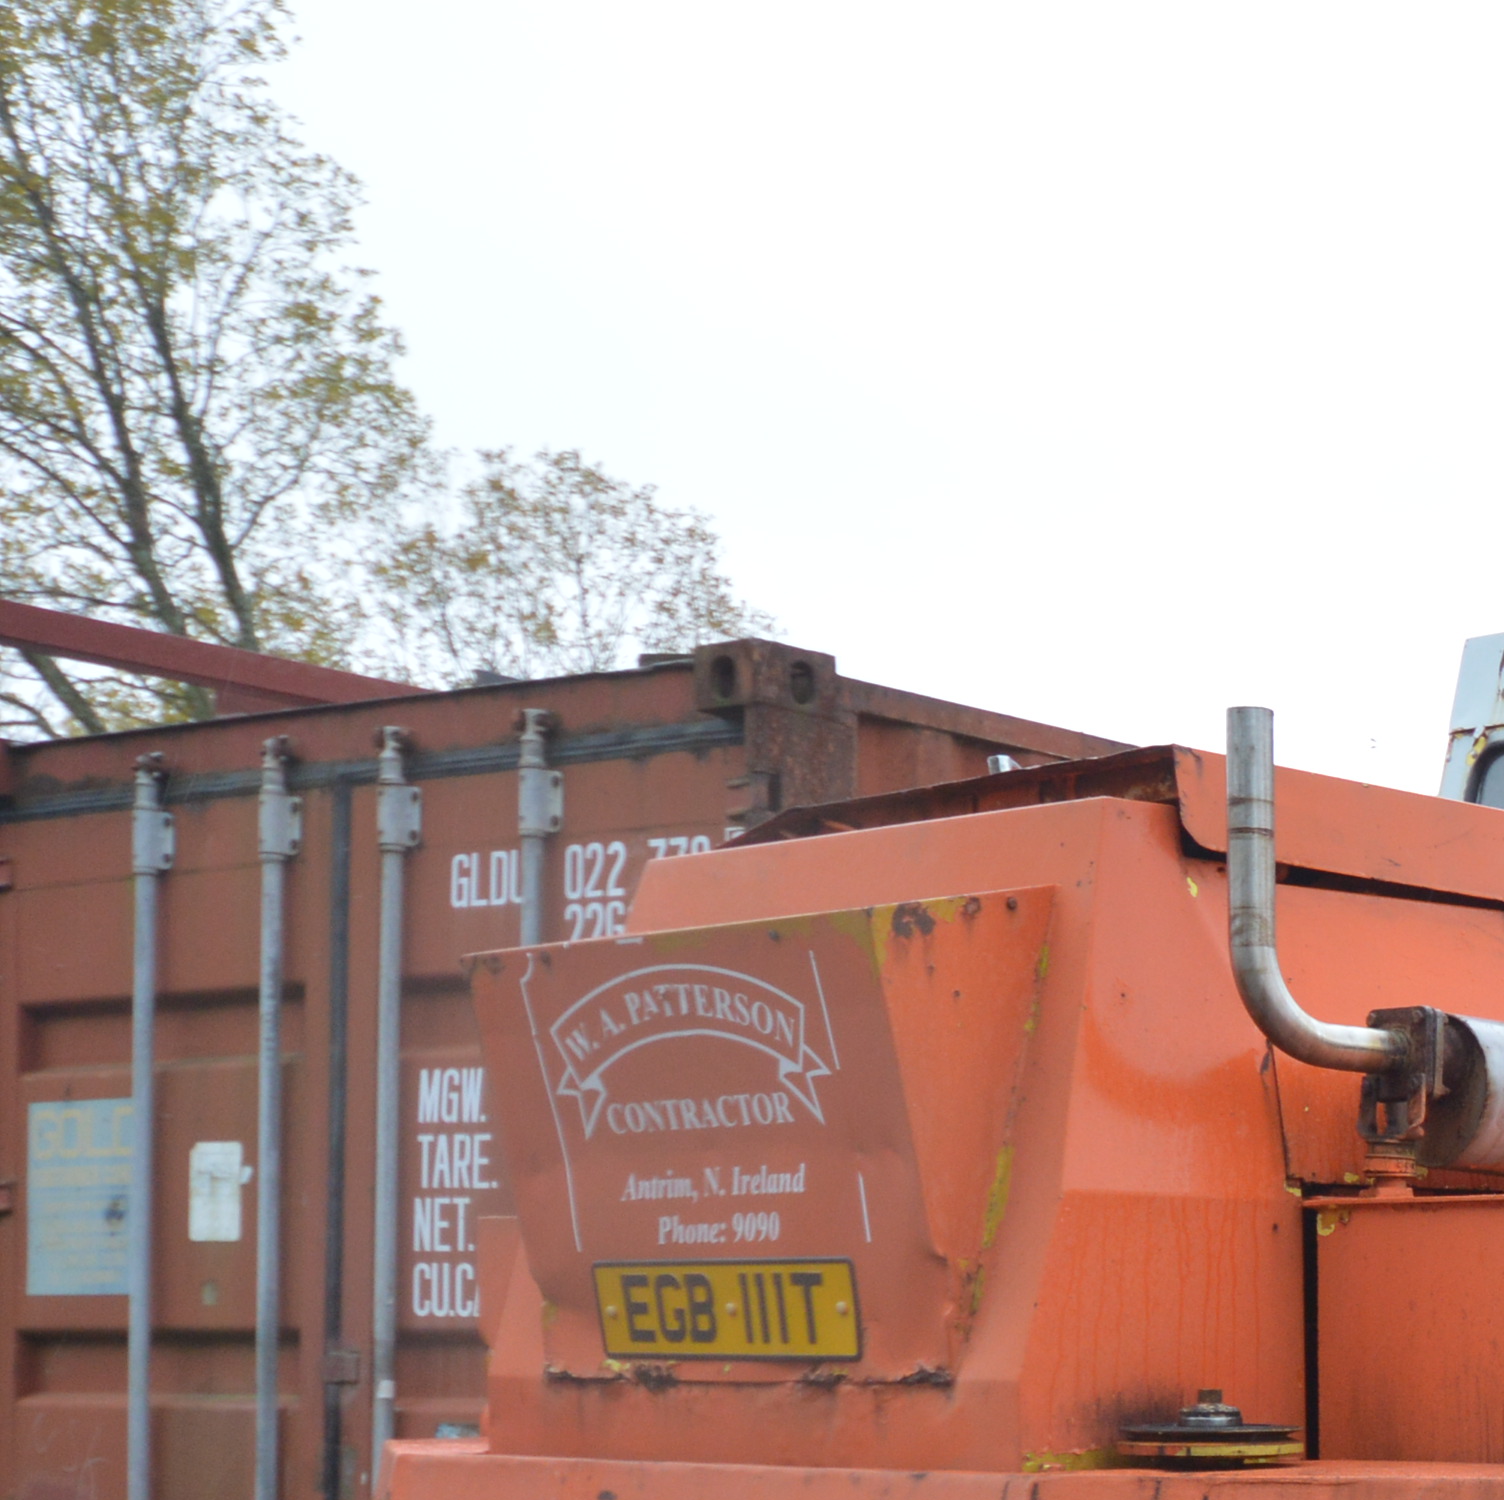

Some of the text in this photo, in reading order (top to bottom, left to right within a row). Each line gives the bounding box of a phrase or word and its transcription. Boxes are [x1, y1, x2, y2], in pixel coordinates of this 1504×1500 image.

[564, 841, 627, 900] 022
[565, 984, 795, 1061] W. A. PATTERSON
[417, 1067, 487, 1123] MGW.
[607, 1092, 795, 1134] CONTRACTOR
[417, 1133, 498, 1189] TARE.
[620, 1163, 806, 1203] Antrim, N. Ireland
[413, 1197, 475, 1251] NET.
[658, 1212, 780, 1244] Phone: 9090
[620, 1273, 717, 1343] EGB
